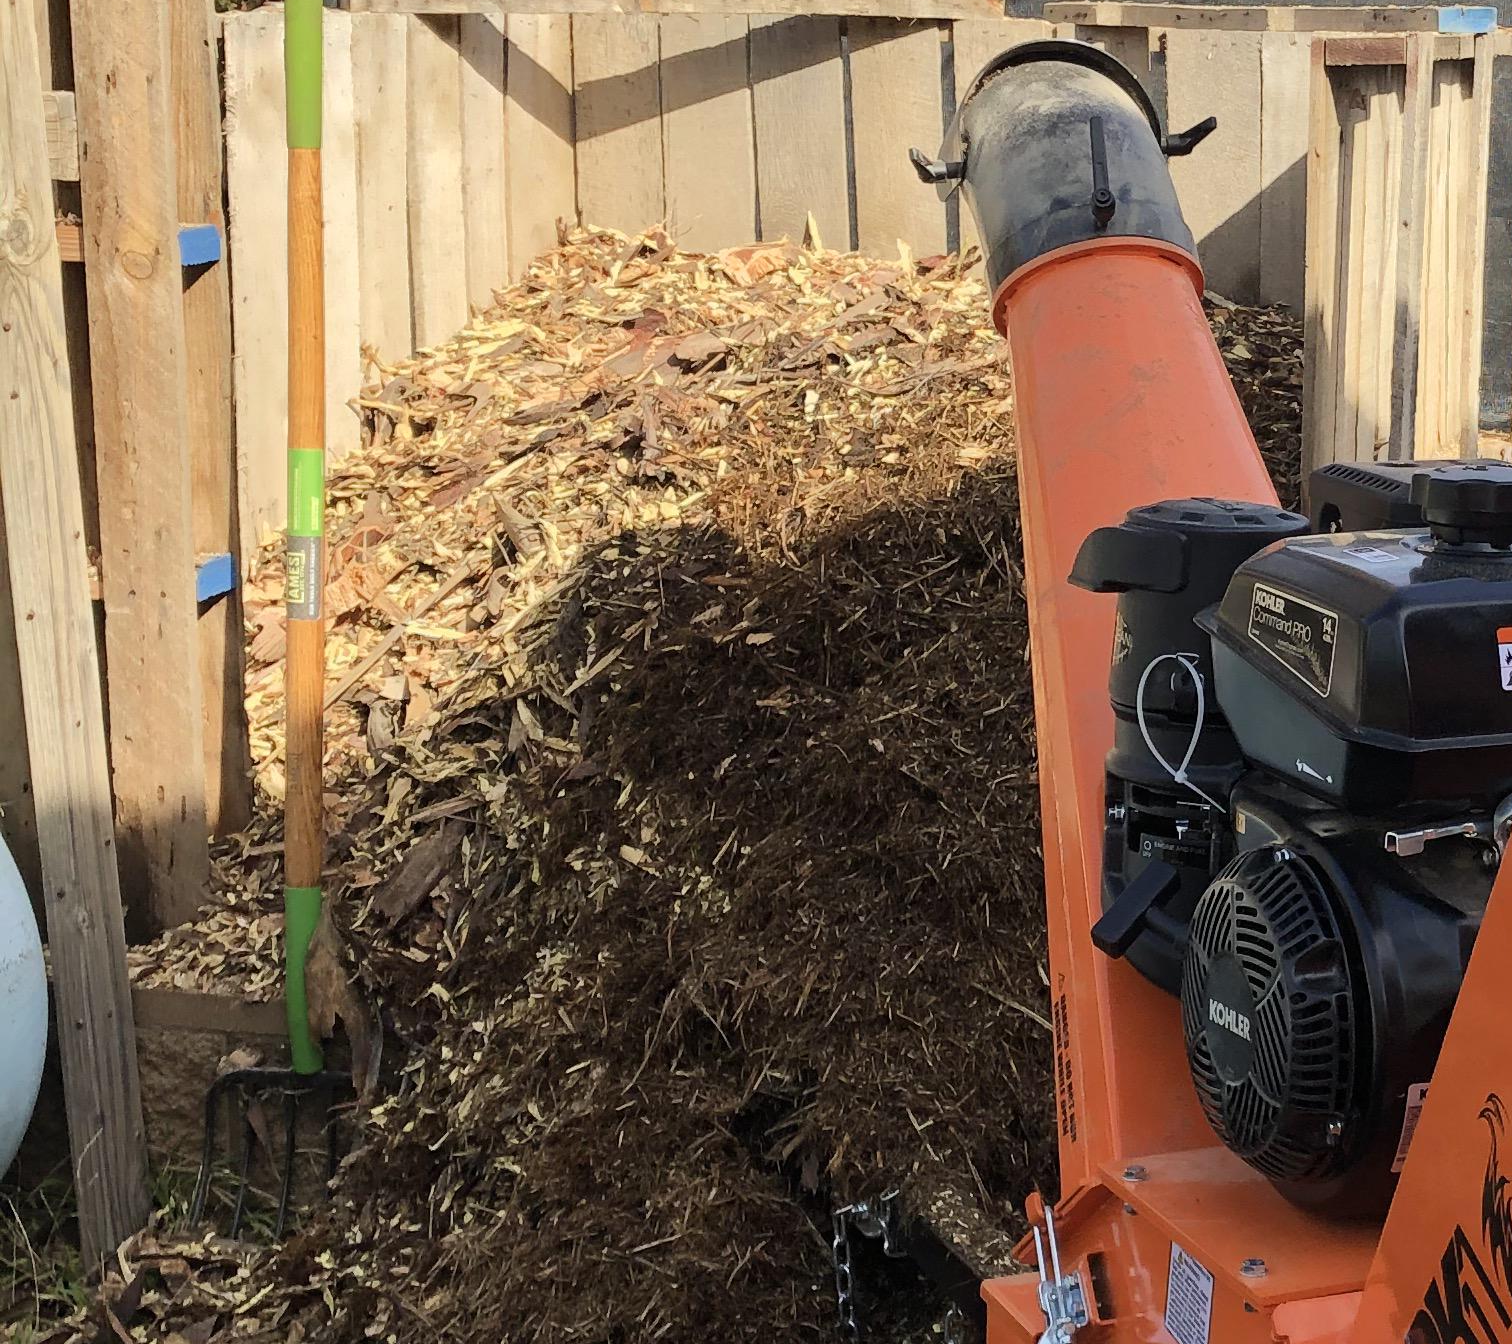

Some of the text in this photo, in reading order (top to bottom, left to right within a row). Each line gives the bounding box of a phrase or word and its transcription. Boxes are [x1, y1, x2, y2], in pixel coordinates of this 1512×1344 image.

[288, 557, 300, 599] AMES
[1255, 589, 1286, 616] KOHLER
[1253, 605, 1312, 643] Command PRO
[1209, 998, 1251, 1042] KOHLER
